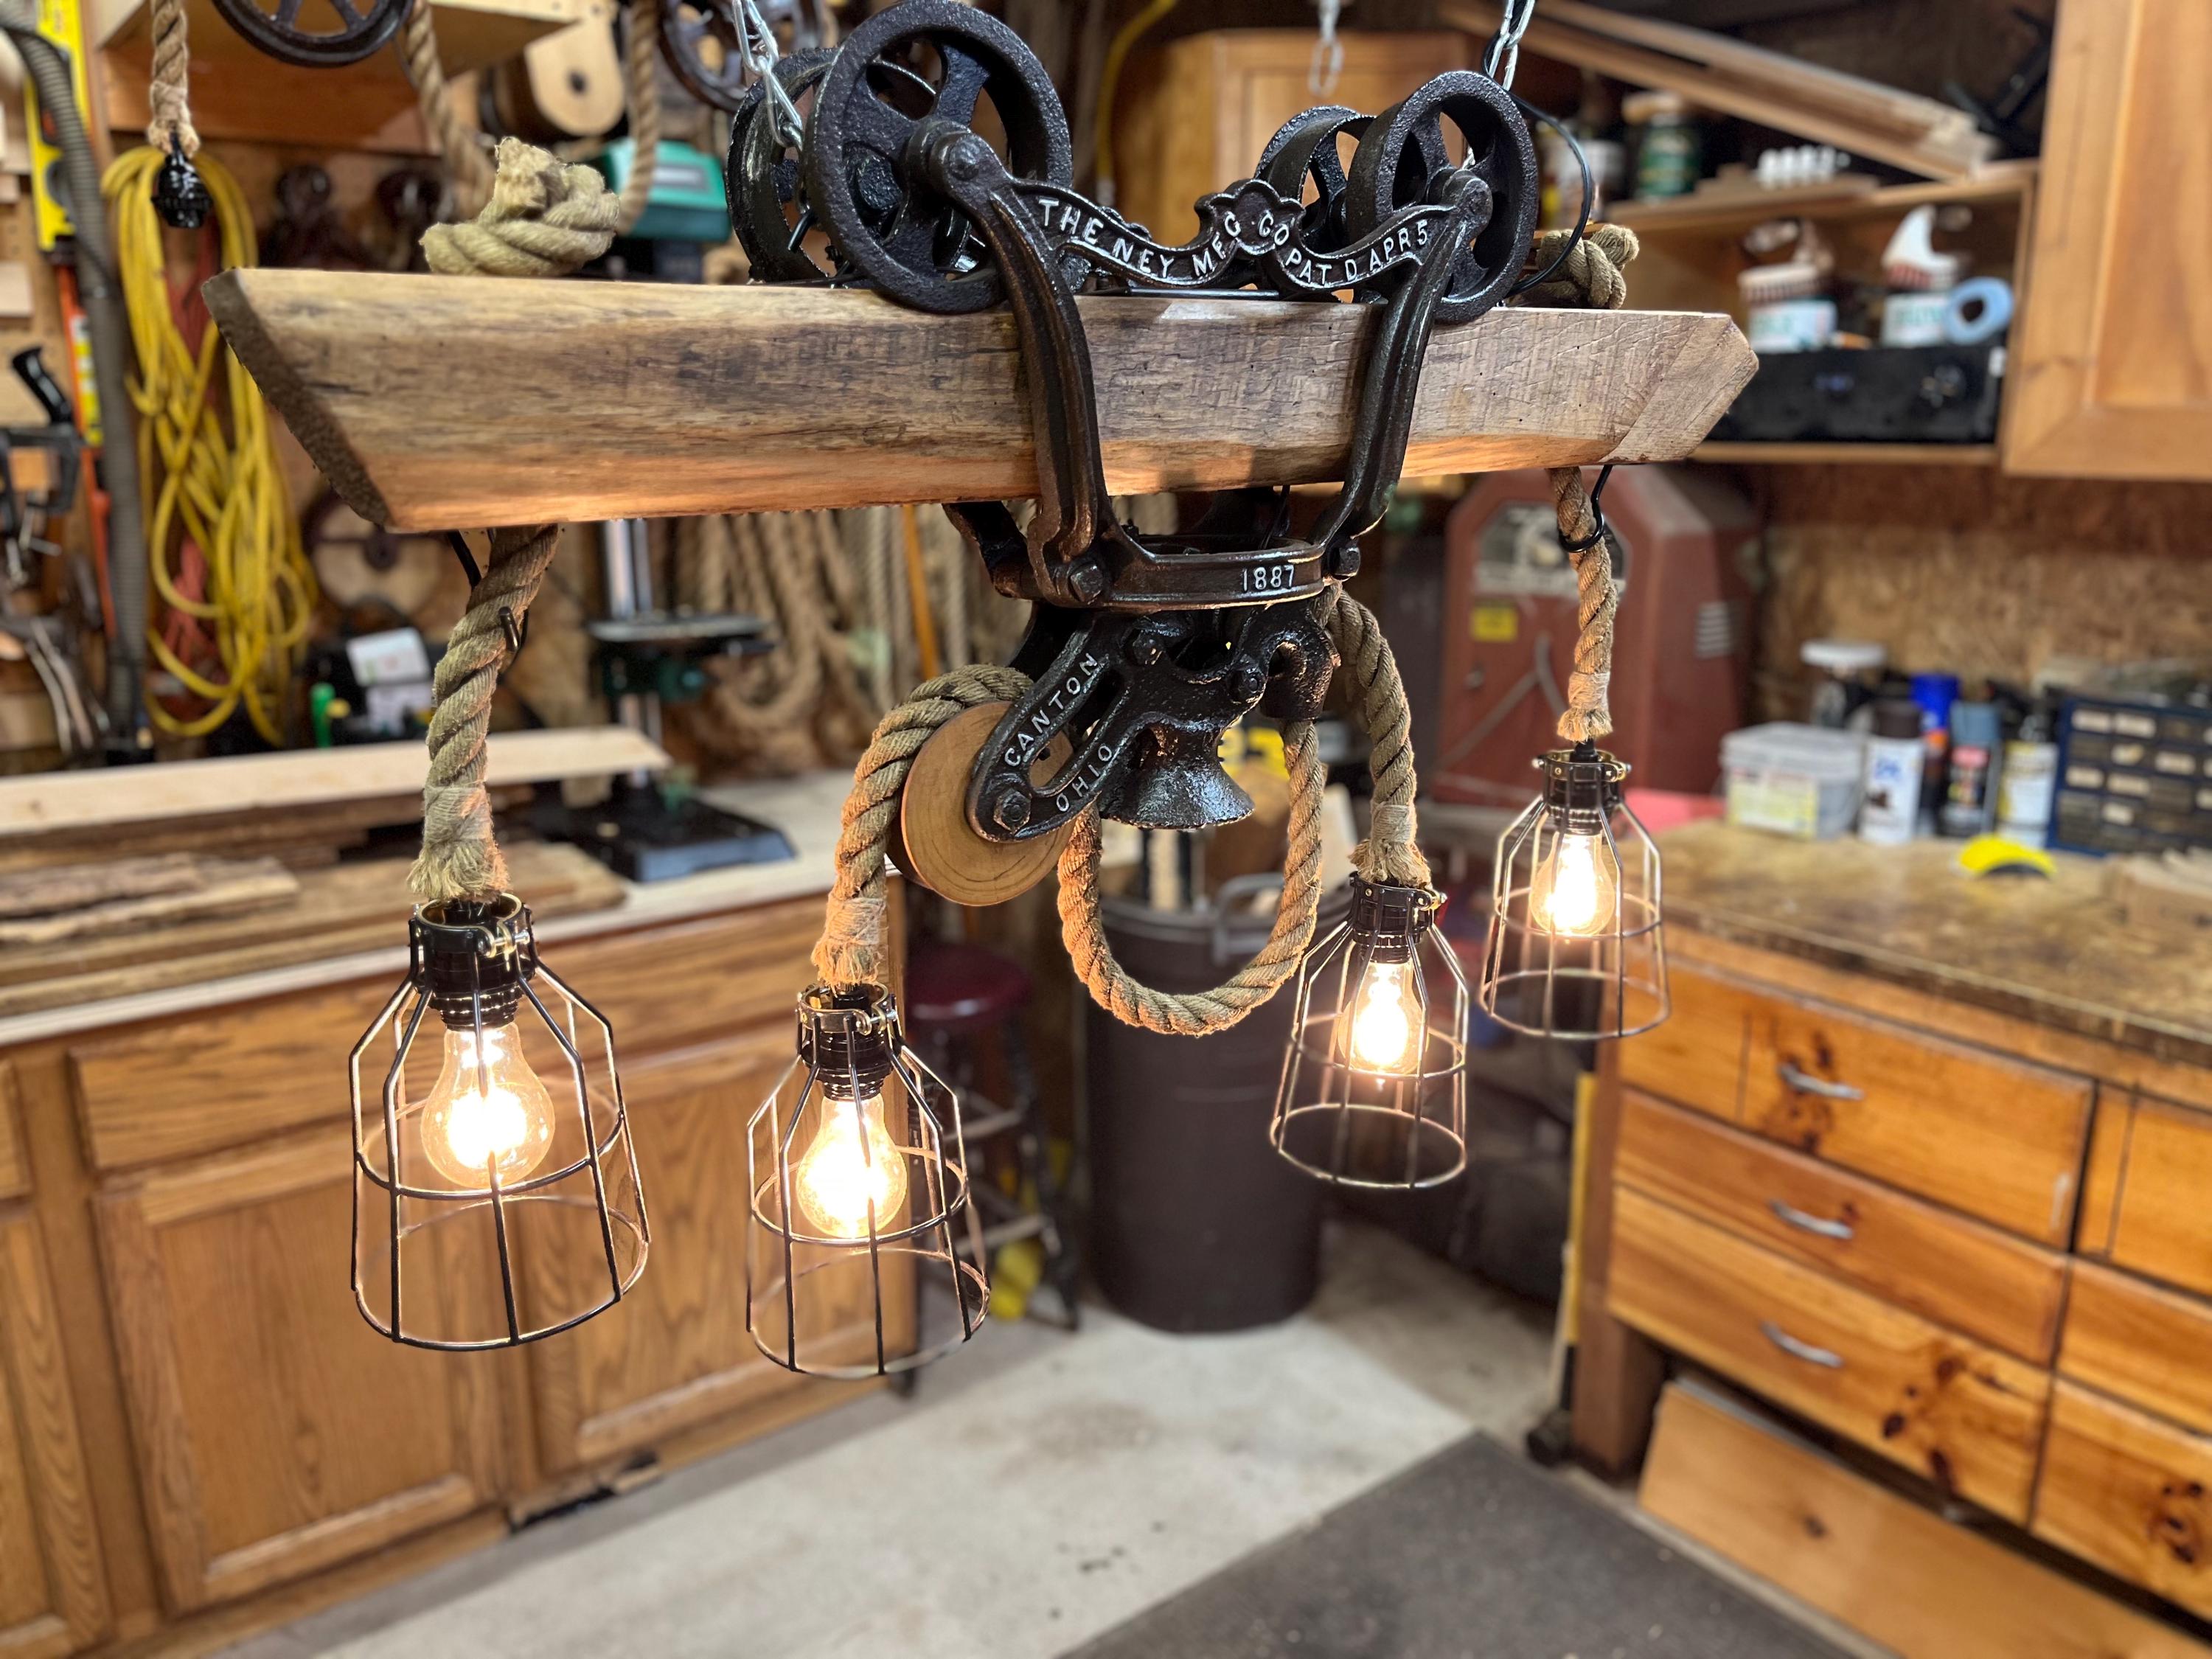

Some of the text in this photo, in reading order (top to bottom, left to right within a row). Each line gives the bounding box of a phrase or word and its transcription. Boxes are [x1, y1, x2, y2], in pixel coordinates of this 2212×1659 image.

[1038, 197, 1105, 245] THE
[1112, 237, 1174, 278] NEY
[1243, 564, 1295, 591] 1887
[1004, 653, 1101, 768] CANTON
[1056, 745, 1113, 812] OHIO
